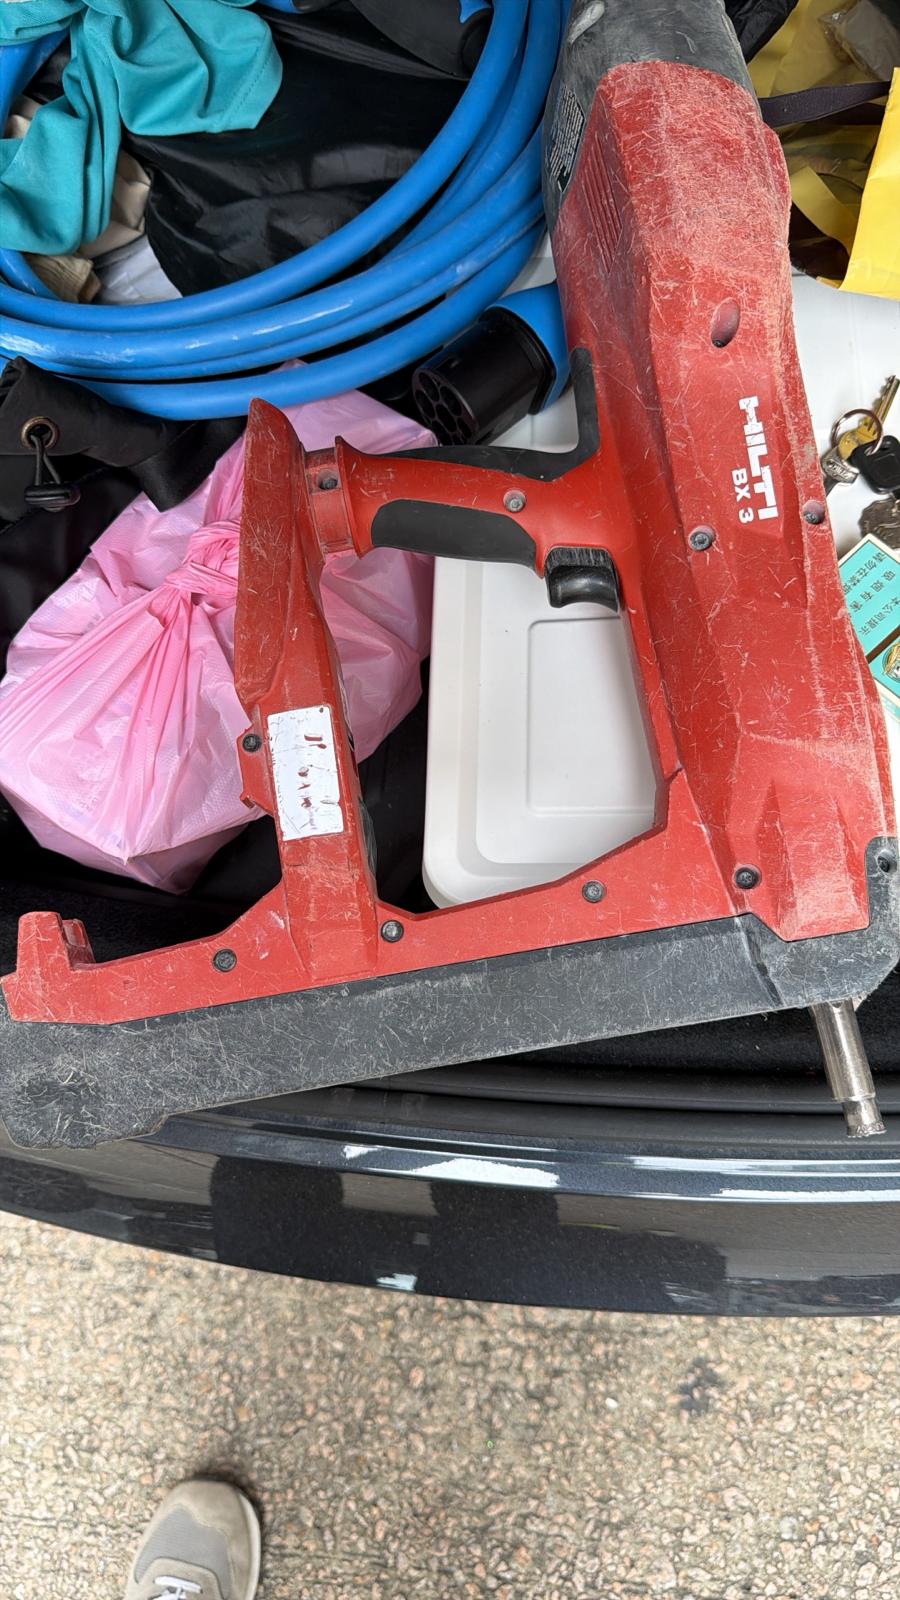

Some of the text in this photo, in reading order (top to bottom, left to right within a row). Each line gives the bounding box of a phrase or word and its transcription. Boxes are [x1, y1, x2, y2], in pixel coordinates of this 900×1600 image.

[738, 395, 779, 520] HILTI
[731, 467, 755, 524] BX 3
[858, 596, 900, 636] 本公司提示
